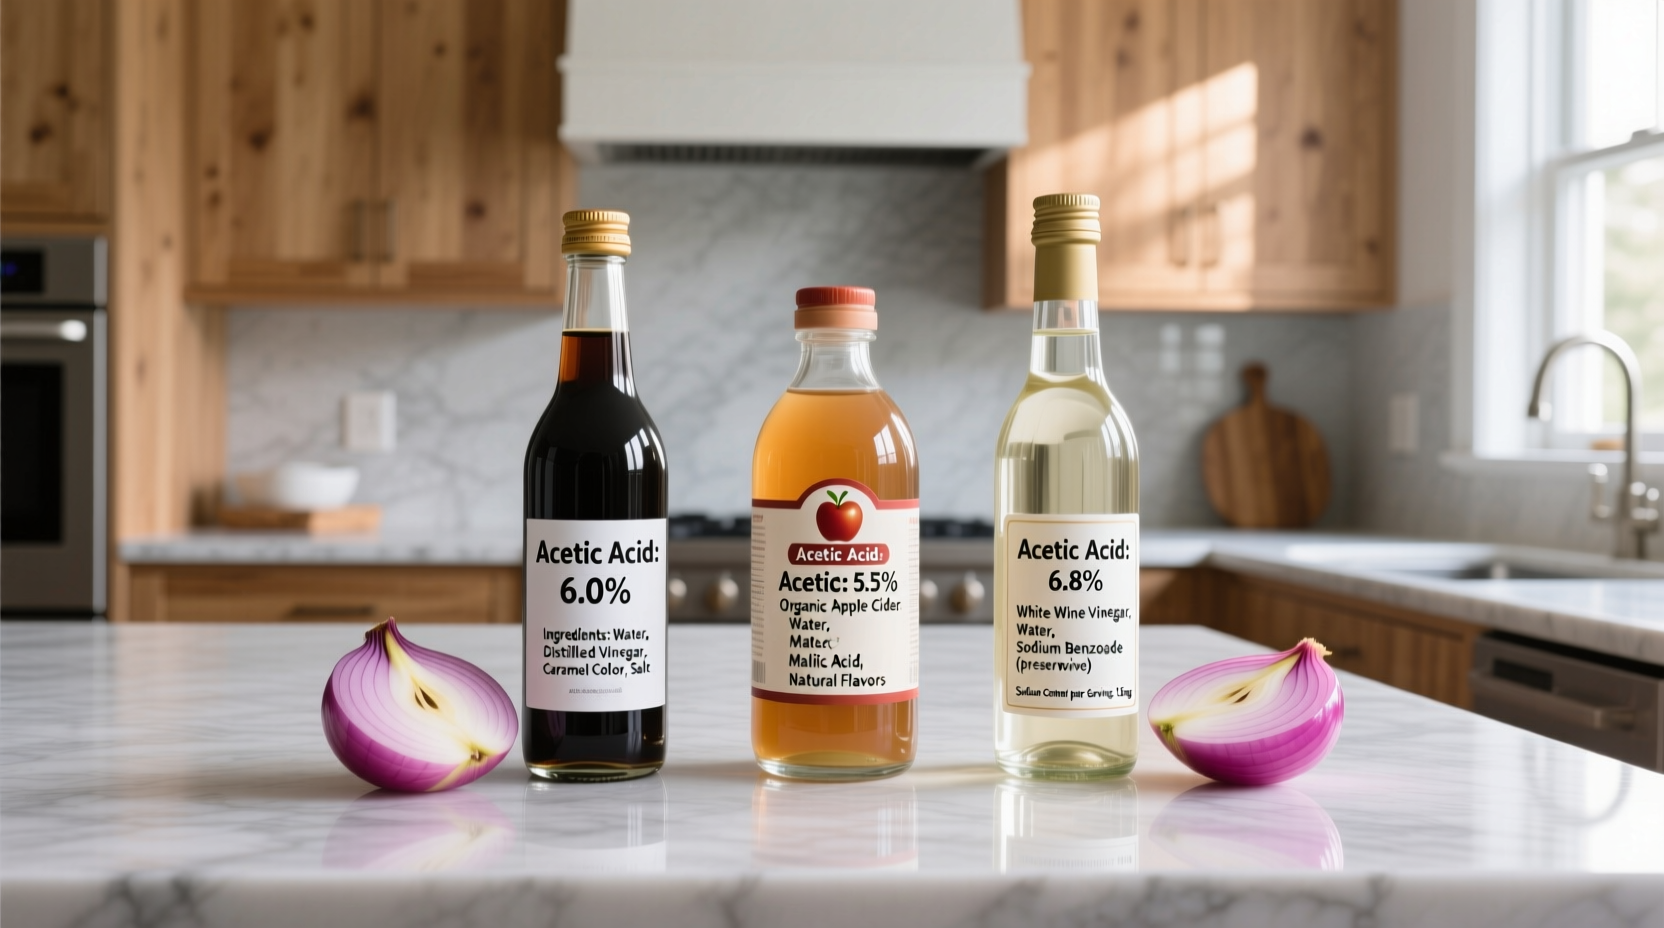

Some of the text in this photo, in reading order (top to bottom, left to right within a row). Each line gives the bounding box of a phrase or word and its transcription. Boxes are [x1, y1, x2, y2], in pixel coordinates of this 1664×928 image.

[536, 539, 660, 564] Acetic Acid:
[796, 546, 842, 562] Acetic
[1018, 538, 1130, 560] Acetic Acid:
[778, 570, 898, 592] Acetic: 5.5%
[1048, 569, 1103, 592] 6.8%
[560, 576, 631, 604] 6.0%
[780, 598, 827, 616] Organic
[830, 598, 868, 616] Apple
[1016, 604, 1052, 619] White
[1054, 606, 1086, 619] Wine
[788, 617, 830, 632] Water,
[1016, 623, 1056, 638] Water,
[1016, 640, 1061, 654] Sodium
[543, 660, 650, 678] Caramel Color, Salt
[831, 654, 864, 670] Acid,
[789, 672, 886, 687] Natural Flavors
